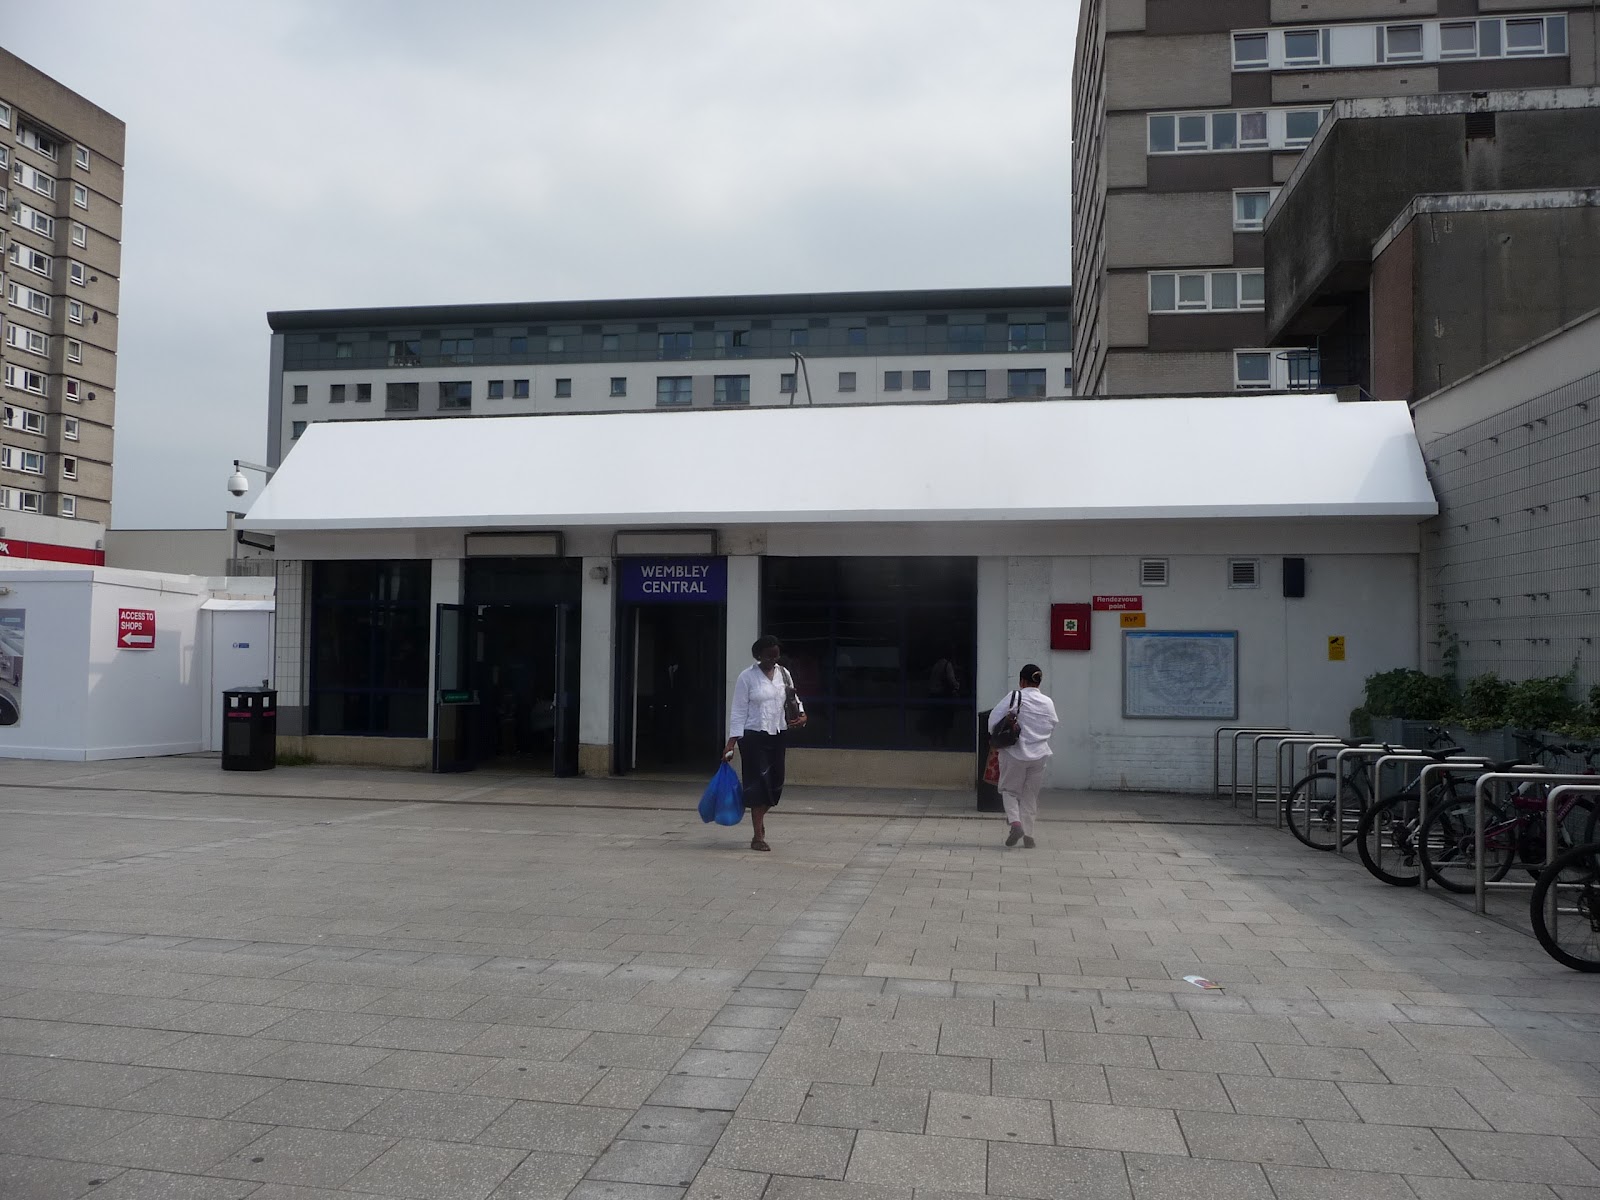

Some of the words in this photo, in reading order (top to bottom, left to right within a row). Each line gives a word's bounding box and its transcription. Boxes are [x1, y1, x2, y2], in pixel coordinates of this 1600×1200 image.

[640, 565, 709, 578] WEMBLEY
[642, 581, 708, 593] CENTRAL
[120, 611, 146, 620] ACCESS
[146, 612, 154, 621] TO
[120, 621, 143, 630] SHOPS
